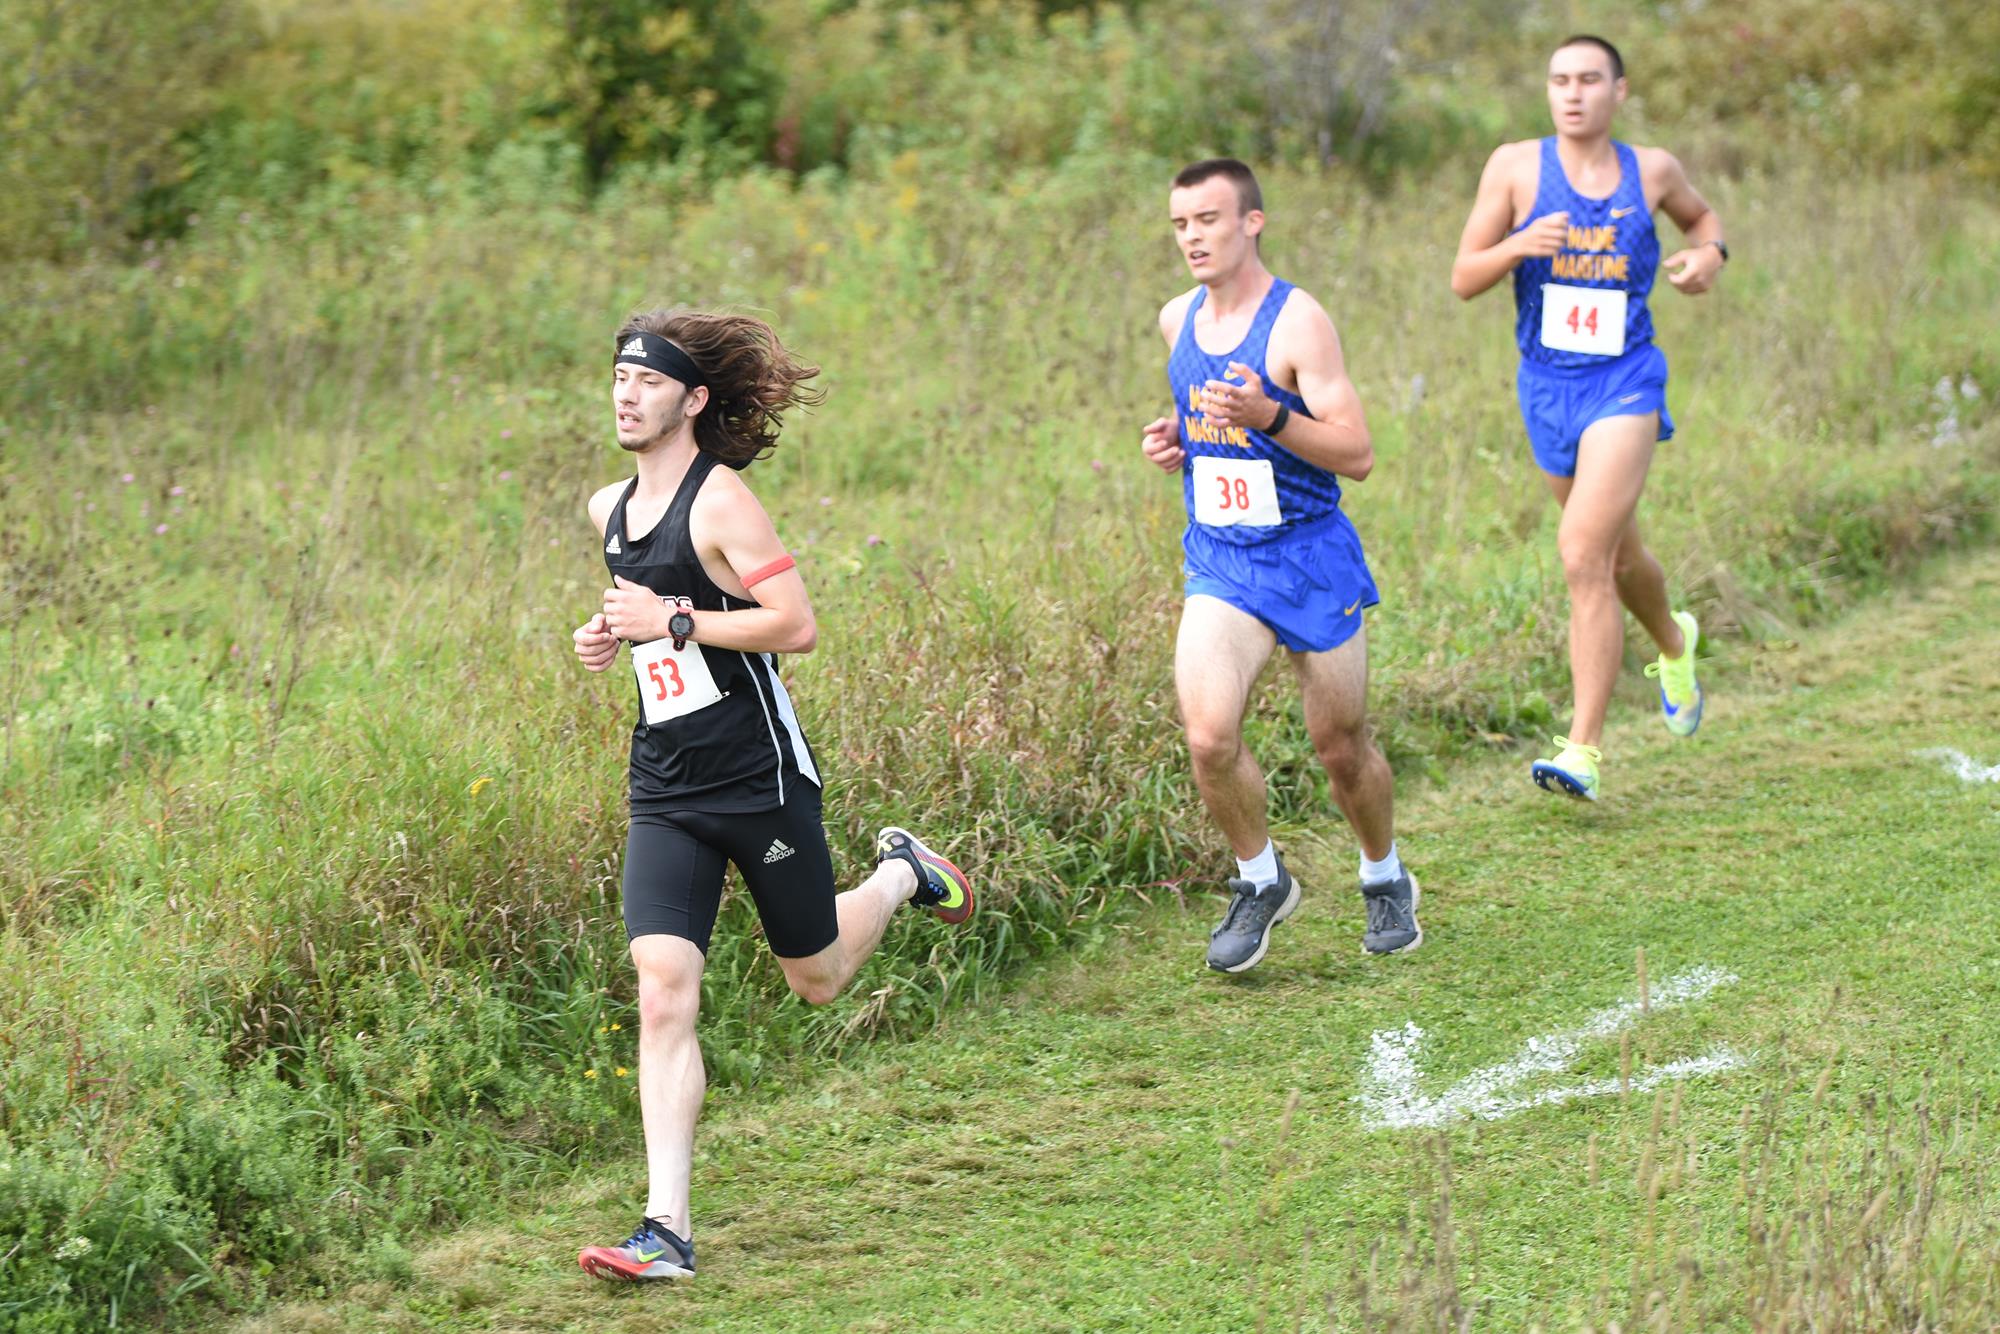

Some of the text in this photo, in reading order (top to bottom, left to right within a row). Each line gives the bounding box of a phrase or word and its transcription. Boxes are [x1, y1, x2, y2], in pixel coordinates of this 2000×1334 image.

[1566, 305, 1598, 336] 44
[1216, 476, 1250, 510] 38
[647, 657, 685, 701] 53
[763, 847, 796, 864] adidas
